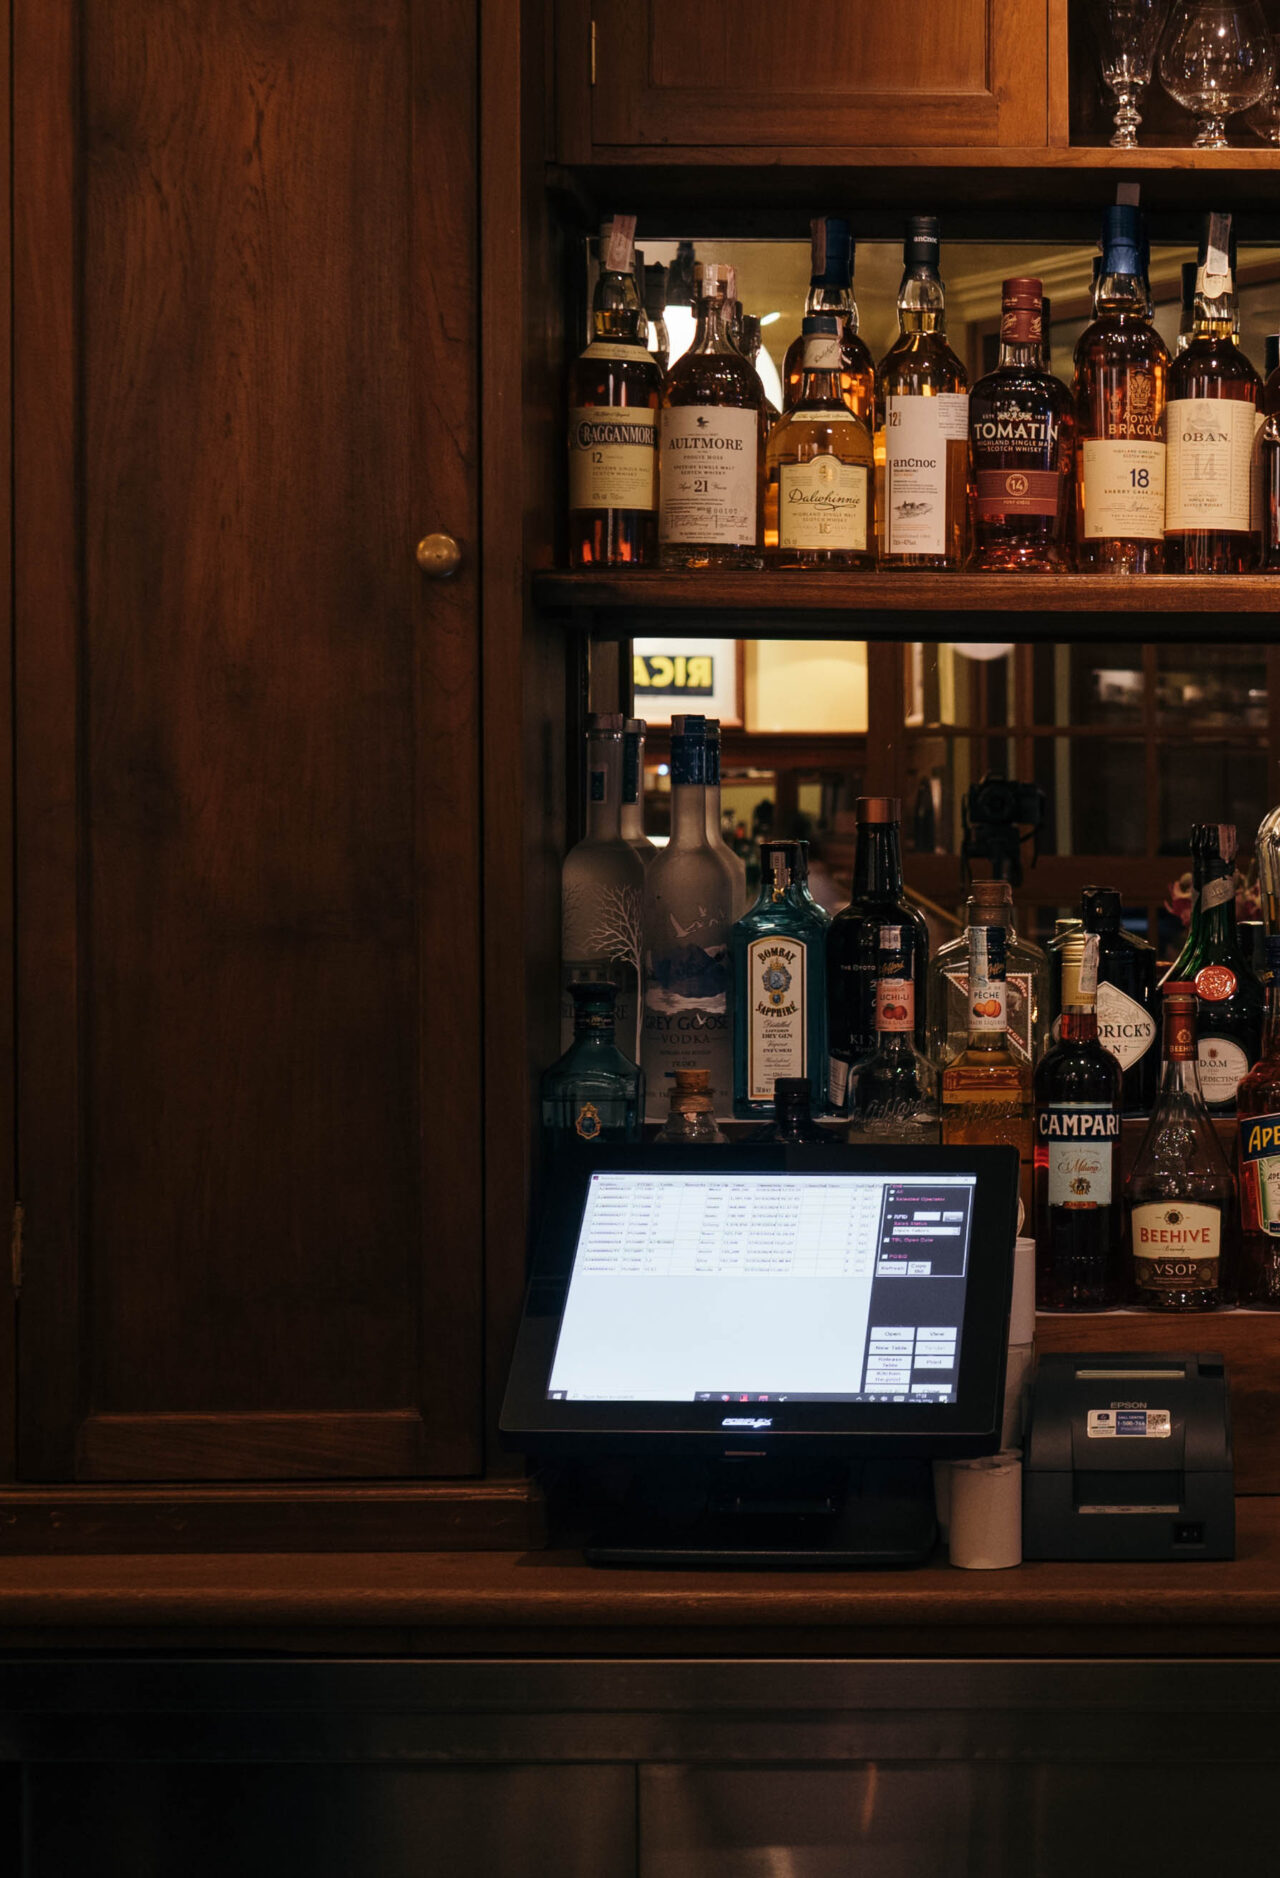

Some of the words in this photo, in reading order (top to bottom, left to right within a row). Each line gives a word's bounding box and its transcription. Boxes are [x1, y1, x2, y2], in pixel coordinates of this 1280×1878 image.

[577, 420, 656, 450] CRAGGANMORE
[974, 422, 1059, 441] TOMATIN
[1108, 424, 1163, 438] BRACKLA
[1182, 432, 1229, 443] OBAN
[669, 437, 743, 451] AULTMORE
[1015, 445, 1042, 453] WHISKY
[592, 451, 603, 464] 12
[893, 458, 937, 469] anCnoc
[1192, 453, 1217, 481] 14
[1010, 479, 1024, 491] 14
[1129, 468, 1150, 488] 18
[694, 479, 709, 493] 21
[788, 487, 861, 506] Dalwhinnie
[758, 946, 797, 965] BOMBAY
[755, 1000, 800, 1018] SAPPHIRE
[1098, 1023, 1151, 1038] DRICK'S
[661, 1034, 711, 1045] VODKA
[1039, 1113, 1120, 1136] CAMPARI
[1140, 1227, 1211, 1243] BEEHIVE
[1154, 1263, 1198, 1276] VSOP
[1110, 1401, 1148, 1409] EPSON
